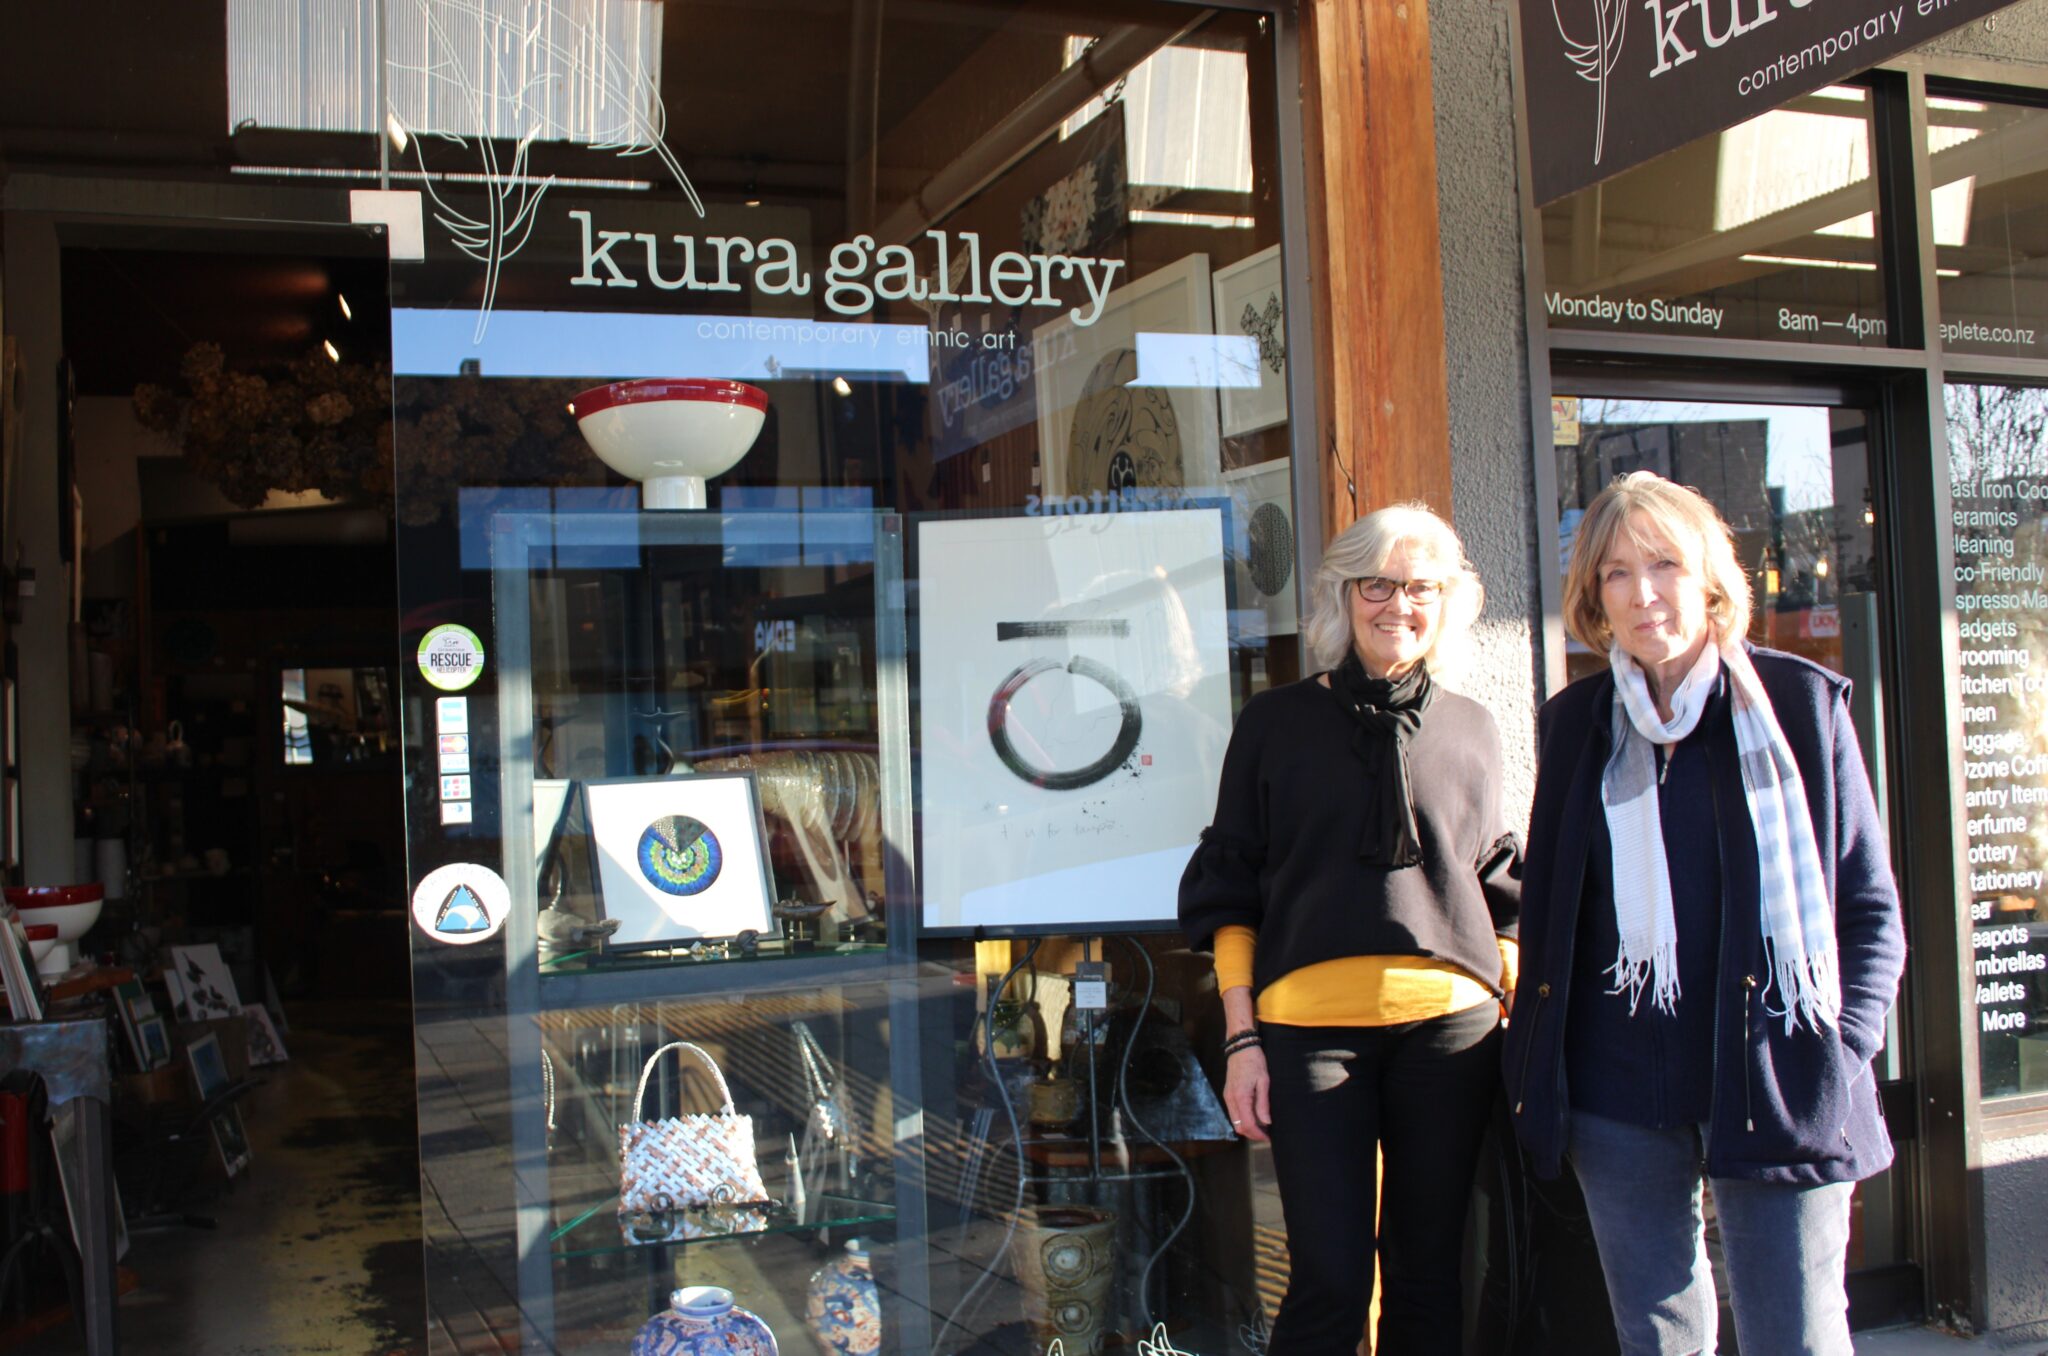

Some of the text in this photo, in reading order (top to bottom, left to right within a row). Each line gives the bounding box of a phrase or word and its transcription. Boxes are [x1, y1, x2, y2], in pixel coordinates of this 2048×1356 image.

[1644, 0, 1815, 79] kur
[1738, 5, 1904, 96] contemporary
[568, 210, 1126, 327] kura gallery
[1544, 291, 1724, 330] Monday to Sunday
[697, 319, 1016, 350] contemporary ethnic art
[1778, 307, 1819, 331] 8am
[1846, 312, 1887, 339] 4pm
[1939, 320, 2035, 344] eplete.co.nz
[1951, 476, 2048, 500] ast Iron Coo
[1953, 506, 2018, 527] eramics
[1954, 534, 2014, 559] leaning
[1954, 561, 2045, 585] co-Friendly
[1955, 589, 2048, 614] spresso Ma
[1960, 617, 2018, 643] adgets
[430, 652, 472, 667] RESCUE
[1960, 644, 2029, 669] rooming
[1961, 672, 2048, 695] itchen Too
[1961, 702, 1997, 723] inen
[1962, 730, 2025, 756] uggage
[2011, 754, 2048, 777] Coff
[1965, 784, 2048, 810] antry Item
[1967, 813, 2027, 836] erfume
[1968, 843, 2019, 865] ottery
[1969, 869, 2044, 892] tationery
[1970, 901, 1993, 920] ea
[1972, 924, 2029, 951] eapots
[1975, 950, 2047, 976] mbrellas
[1975, 981, 2026, 1005] allets
[1982, 1010, 2026, 1032] More
